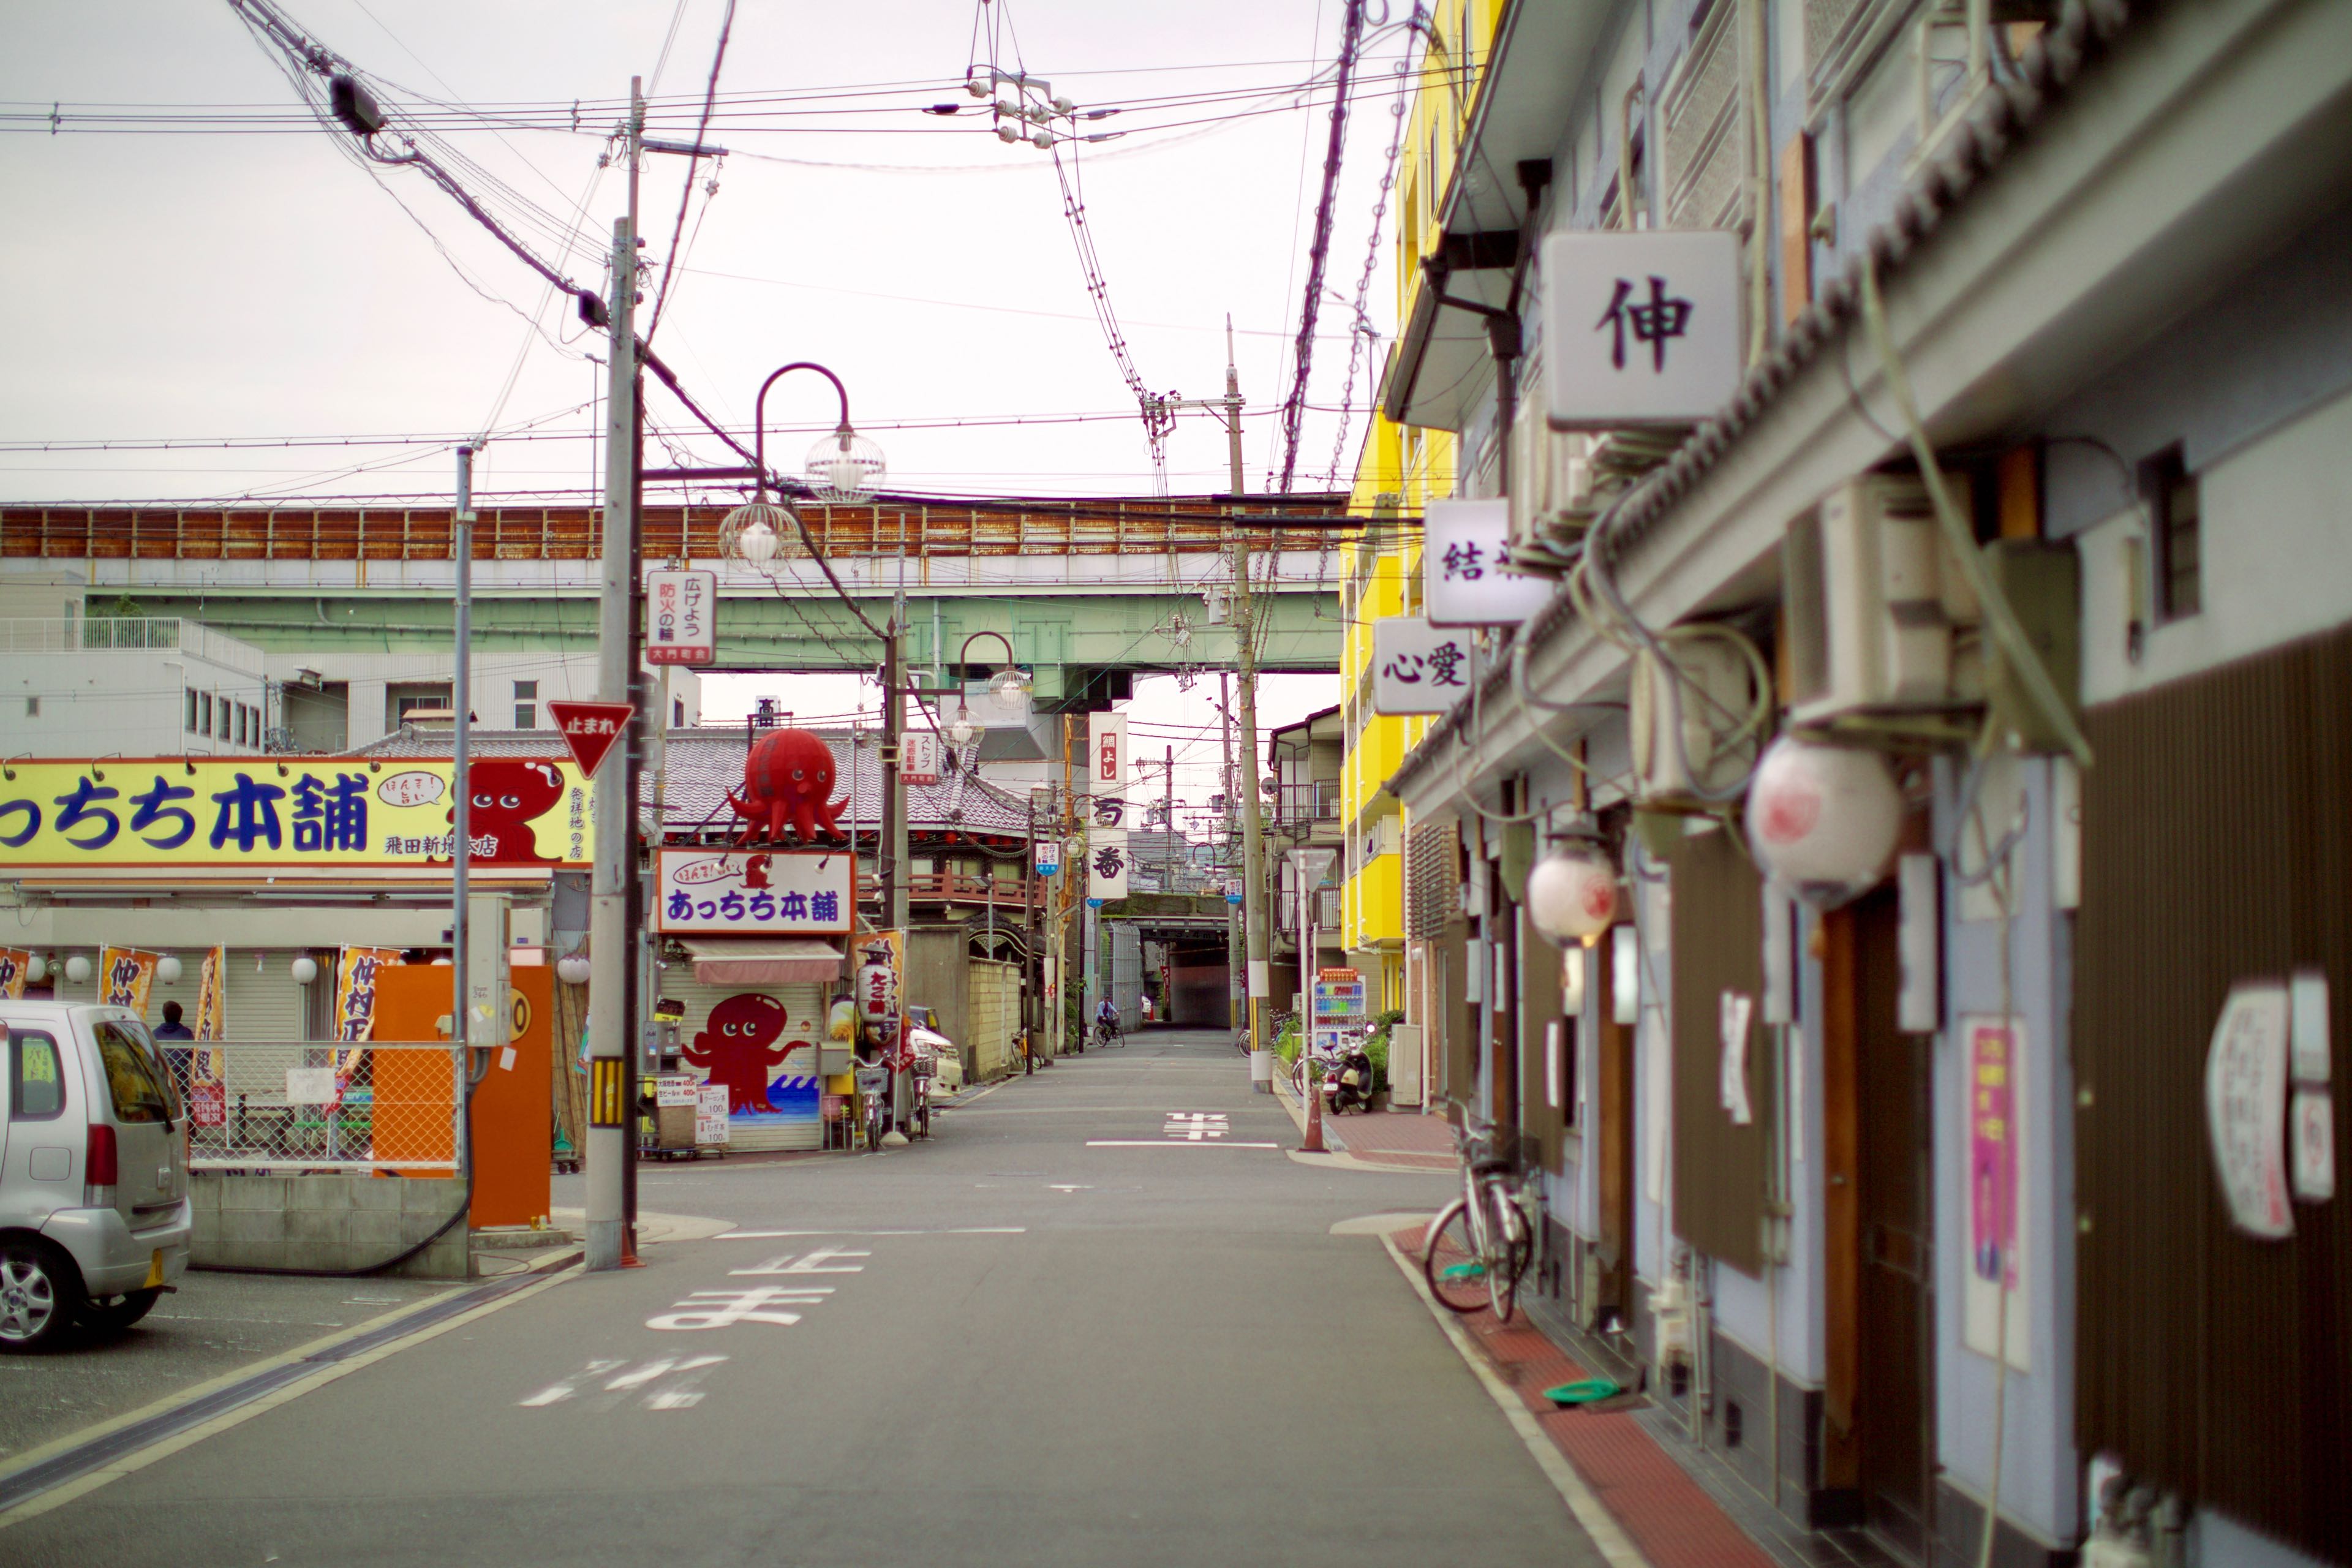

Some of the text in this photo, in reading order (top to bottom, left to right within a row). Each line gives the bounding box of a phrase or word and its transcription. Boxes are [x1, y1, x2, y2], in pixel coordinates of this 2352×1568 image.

[1596, 276, 1695, 374] 伸
[658, 584, 676, 642] 防火の輪
[684, 578, 701, 637] 広げよう
[653, 649, 706, 658] 大門町会
[1383, 641, 1468, 687] 心愛
[565, 717, 616, 735] 止まれ
[921, 736, 931, 769] ストップ
[570, 787, 584, 858] 発祥地の店
[667, 889, 839, 922] あっちち本舗
